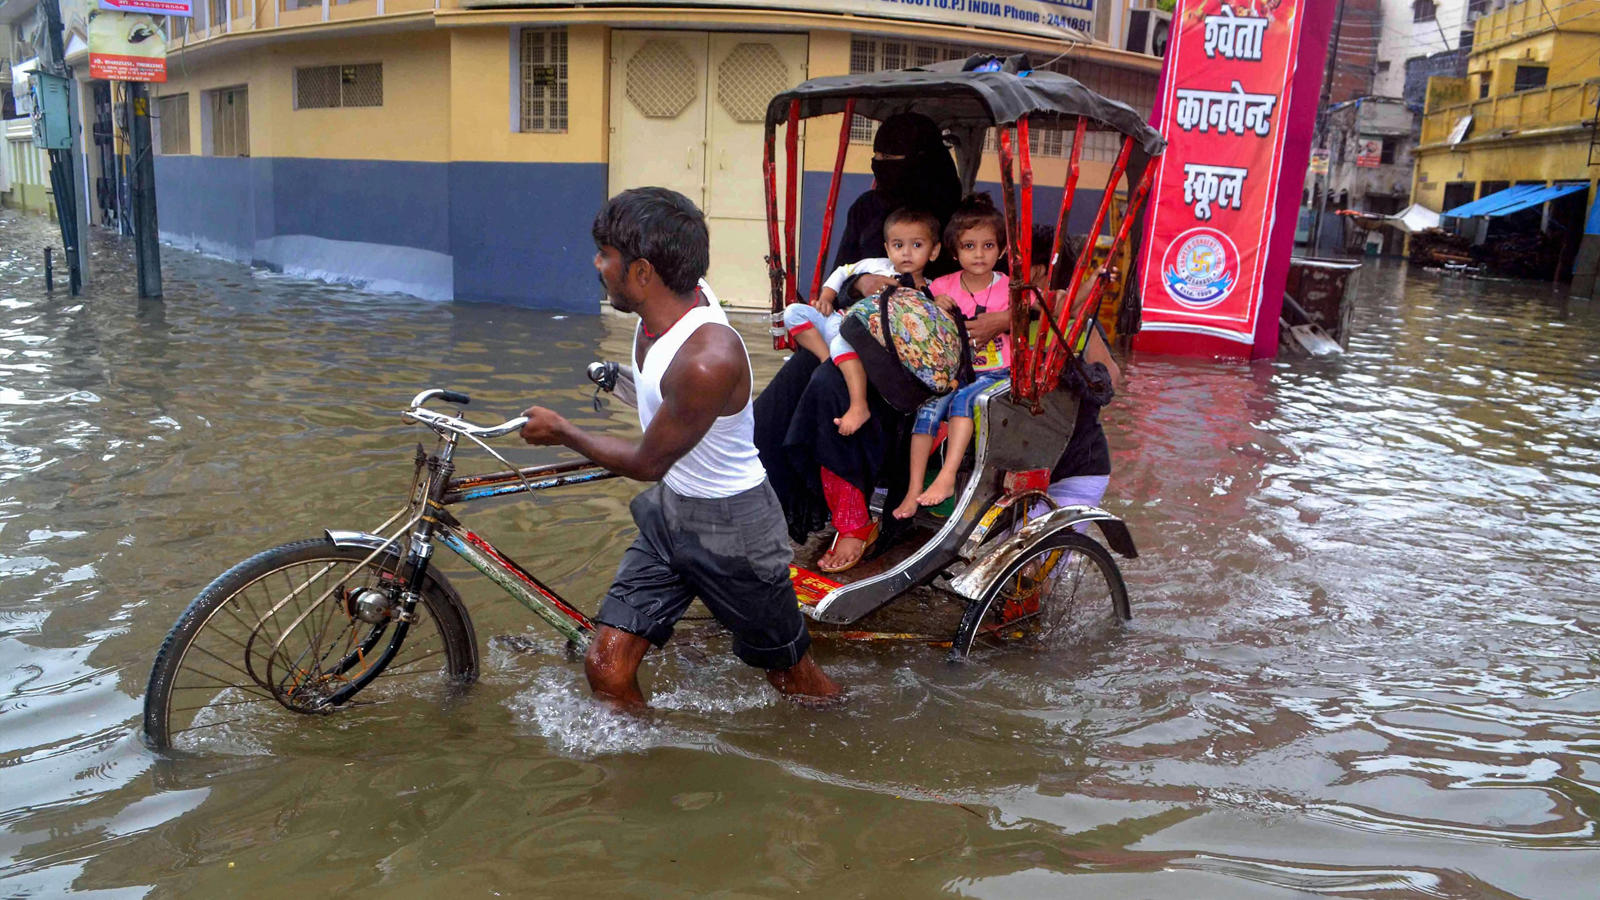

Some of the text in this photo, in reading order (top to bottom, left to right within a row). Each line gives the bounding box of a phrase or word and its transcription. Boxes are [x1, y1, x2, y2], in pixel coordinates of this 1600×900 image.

[968, 0, 1001, 16] INDIA
[1004, 5, 1040, 23] Phone
[1047, 13, 1091, 32] 2441891
[1204, 4, 1268, 61] श्वेता
[1176, 81, 1276, 136] कानवेन्ट
[1184, 164, 1247, 221] स्कूल
